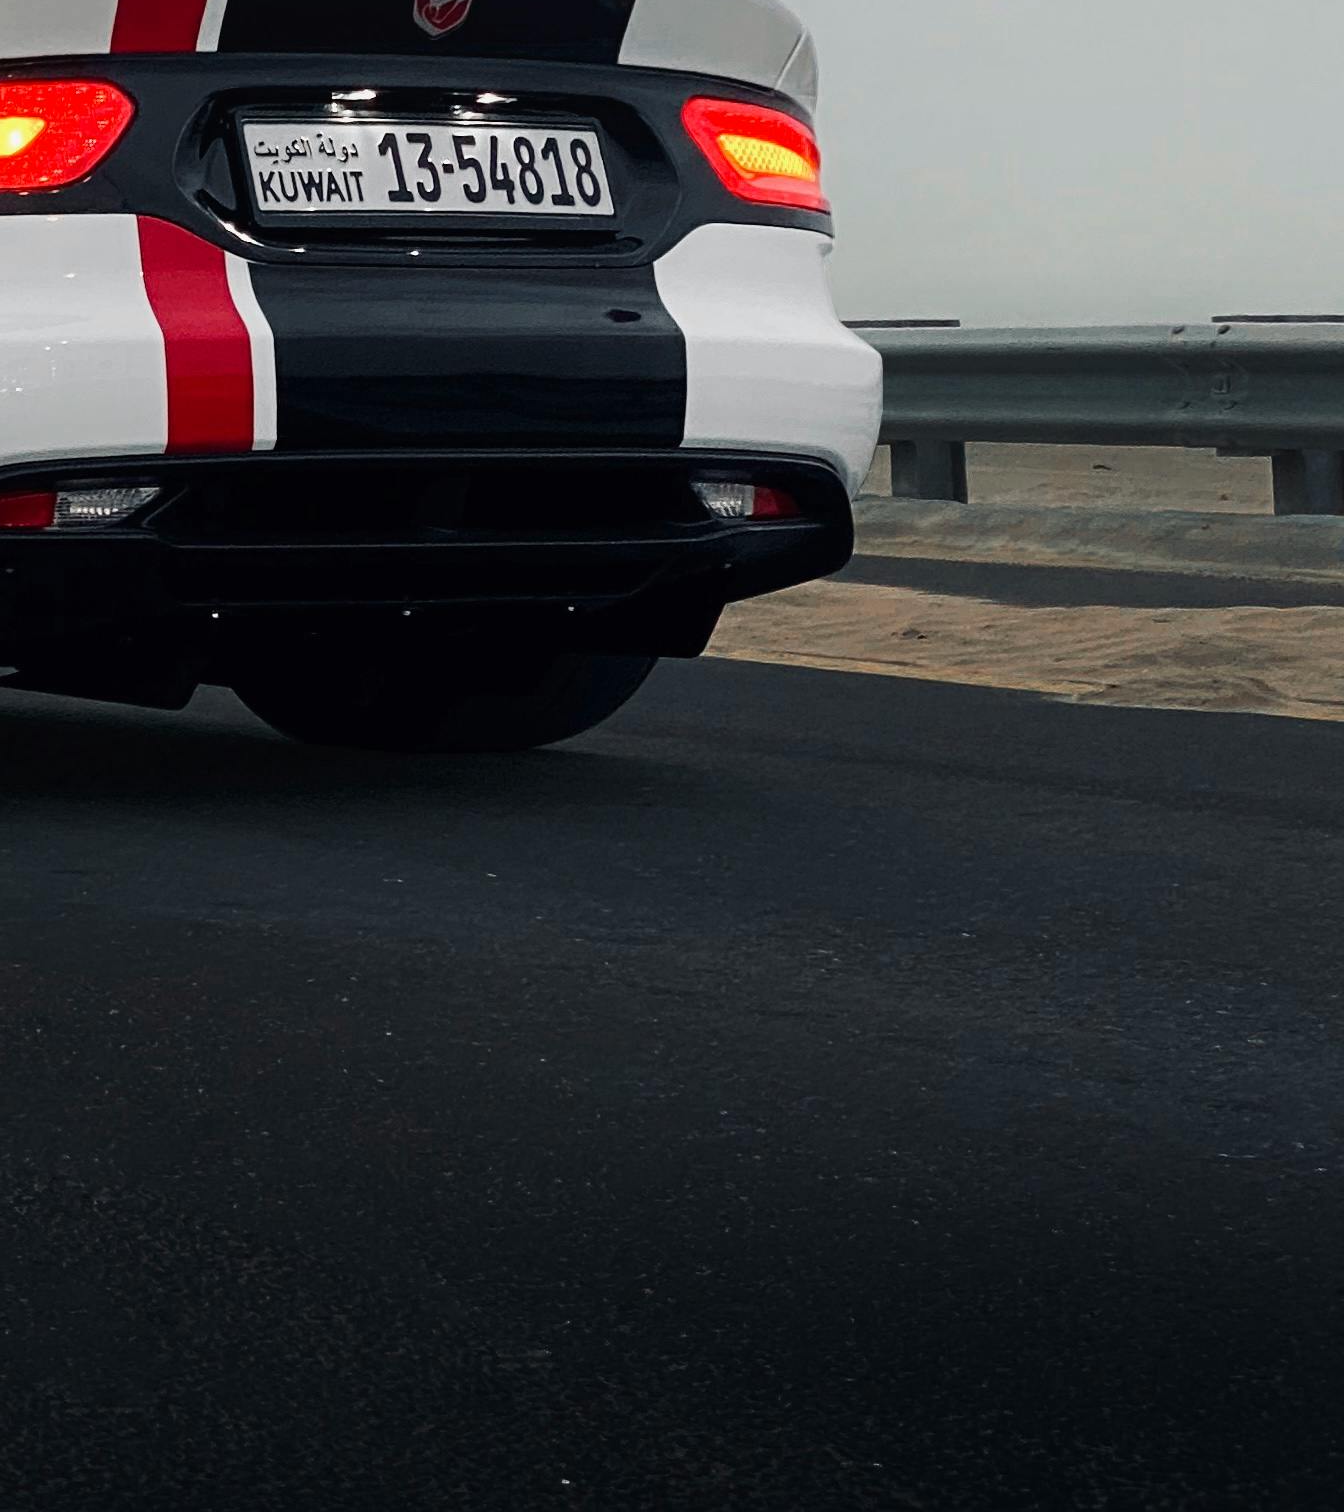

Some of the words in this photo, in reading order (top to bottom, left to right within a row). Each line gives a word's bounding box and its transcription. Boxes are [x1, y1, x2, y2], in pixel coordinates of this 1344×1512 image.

[254, 137, 312, 165] الكويت
[316, 133, 359, 163] دولة
[378, 132, 602, 207] 13-54818
[258, 170, 364, 203] KUWAIT
